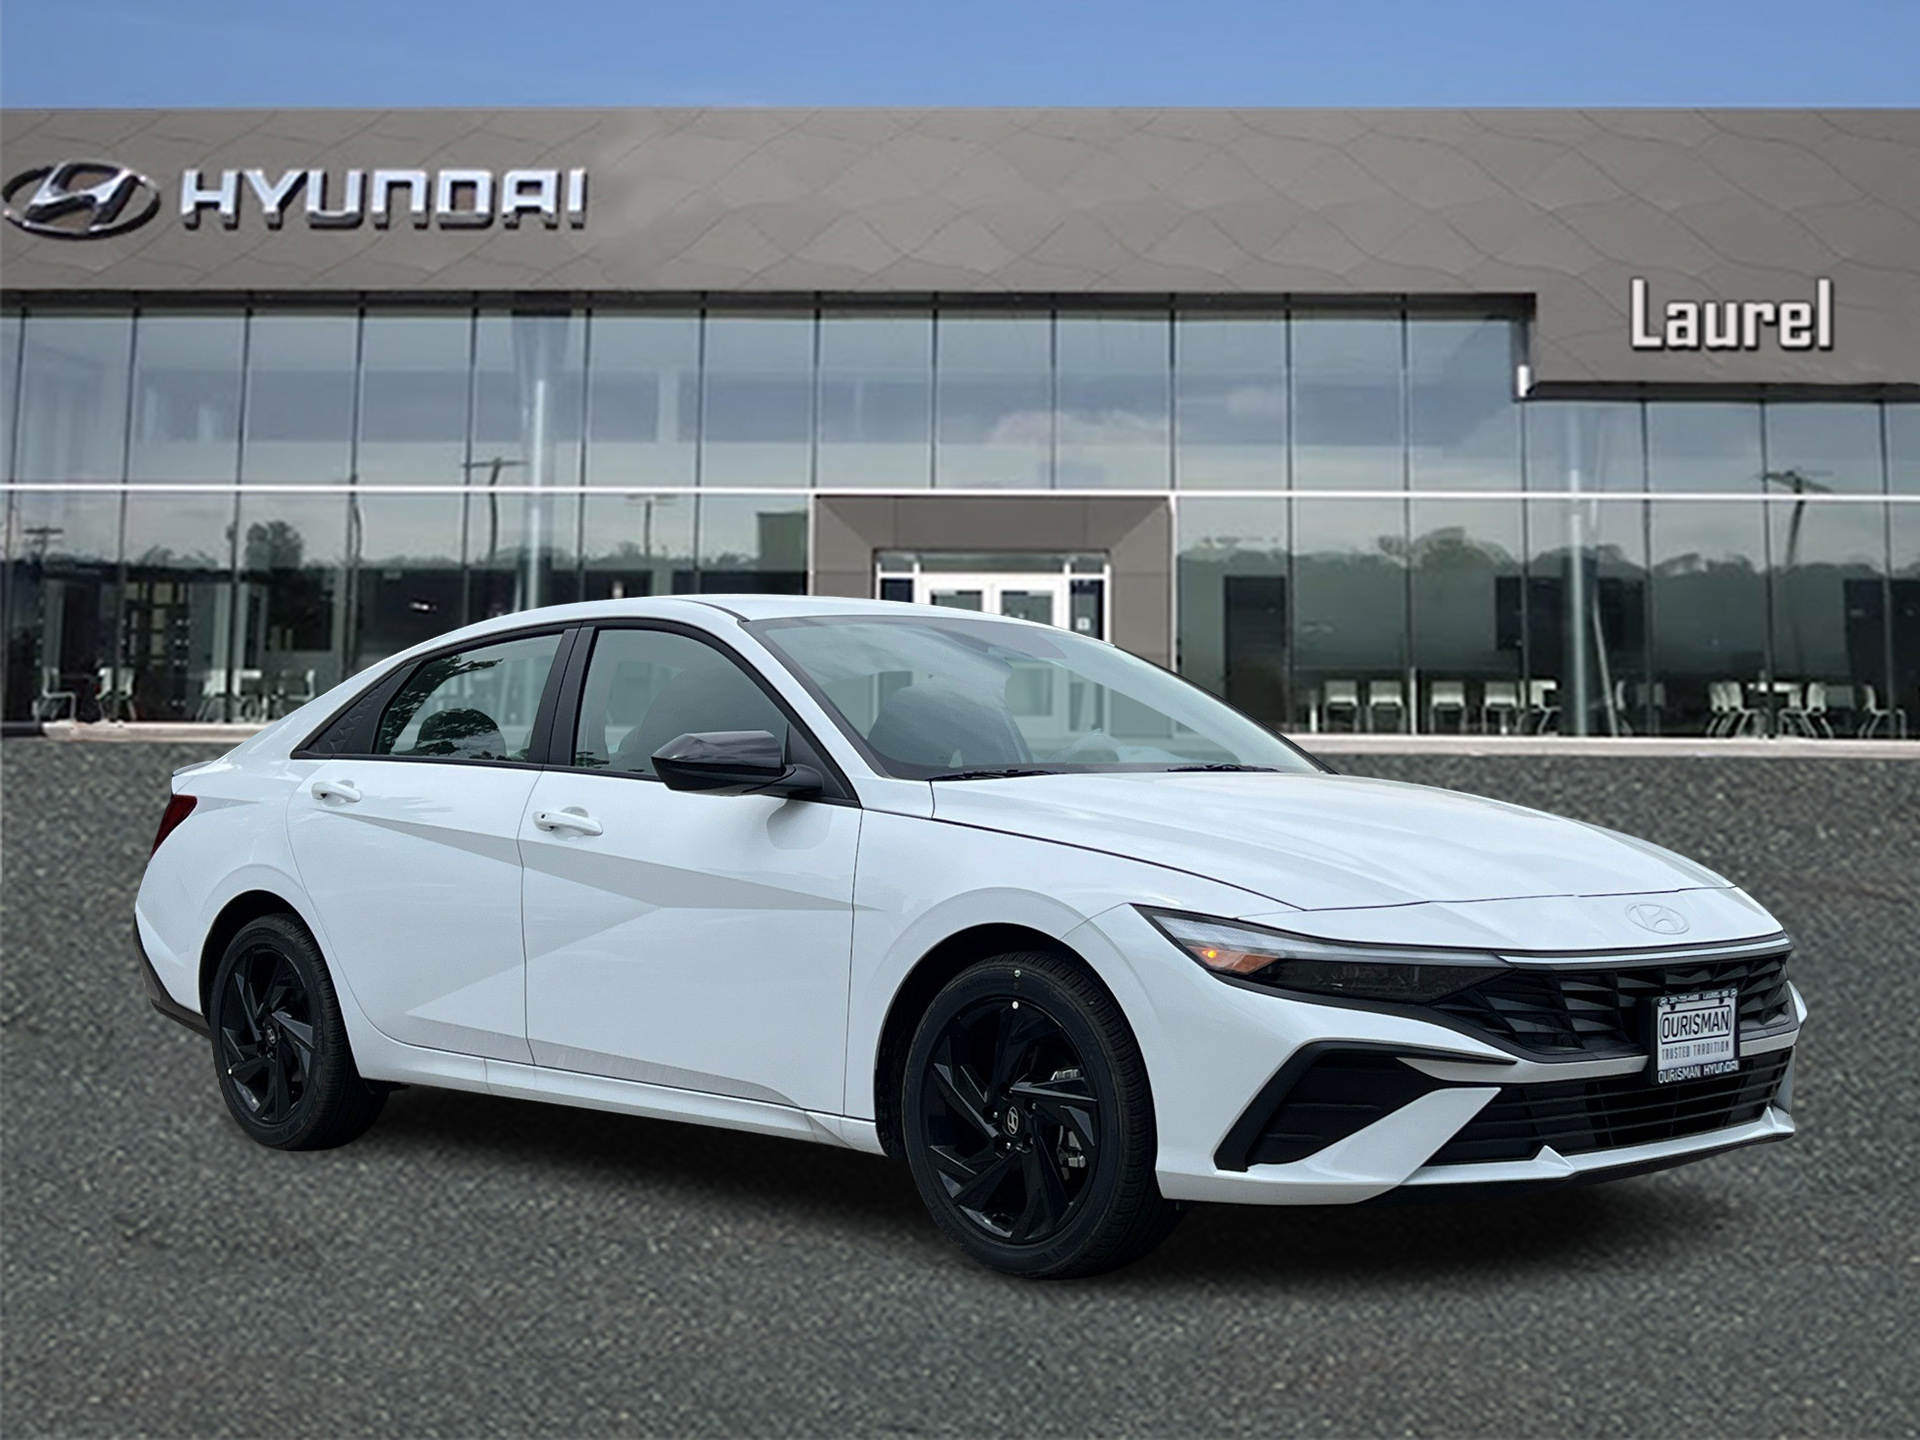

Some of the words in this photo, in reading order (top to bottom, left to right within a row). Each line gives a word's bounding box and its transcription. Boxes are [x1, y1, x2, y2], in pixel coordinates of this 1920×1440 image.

[181, 168, 587, 228] HYUNDAI
[1631, 278, 1833, 349] Laurel
[1662, 1010, 1730, 1039] OURISMAN
[1661, 1045, 1690, 1060] TRUSTED
[1693, 1040, 1730, 1057] TRADITION
[1658, 1064, 1701, 1084] OURISMAN
[1703, 1060, 1740, 1076] HYUNDAI
